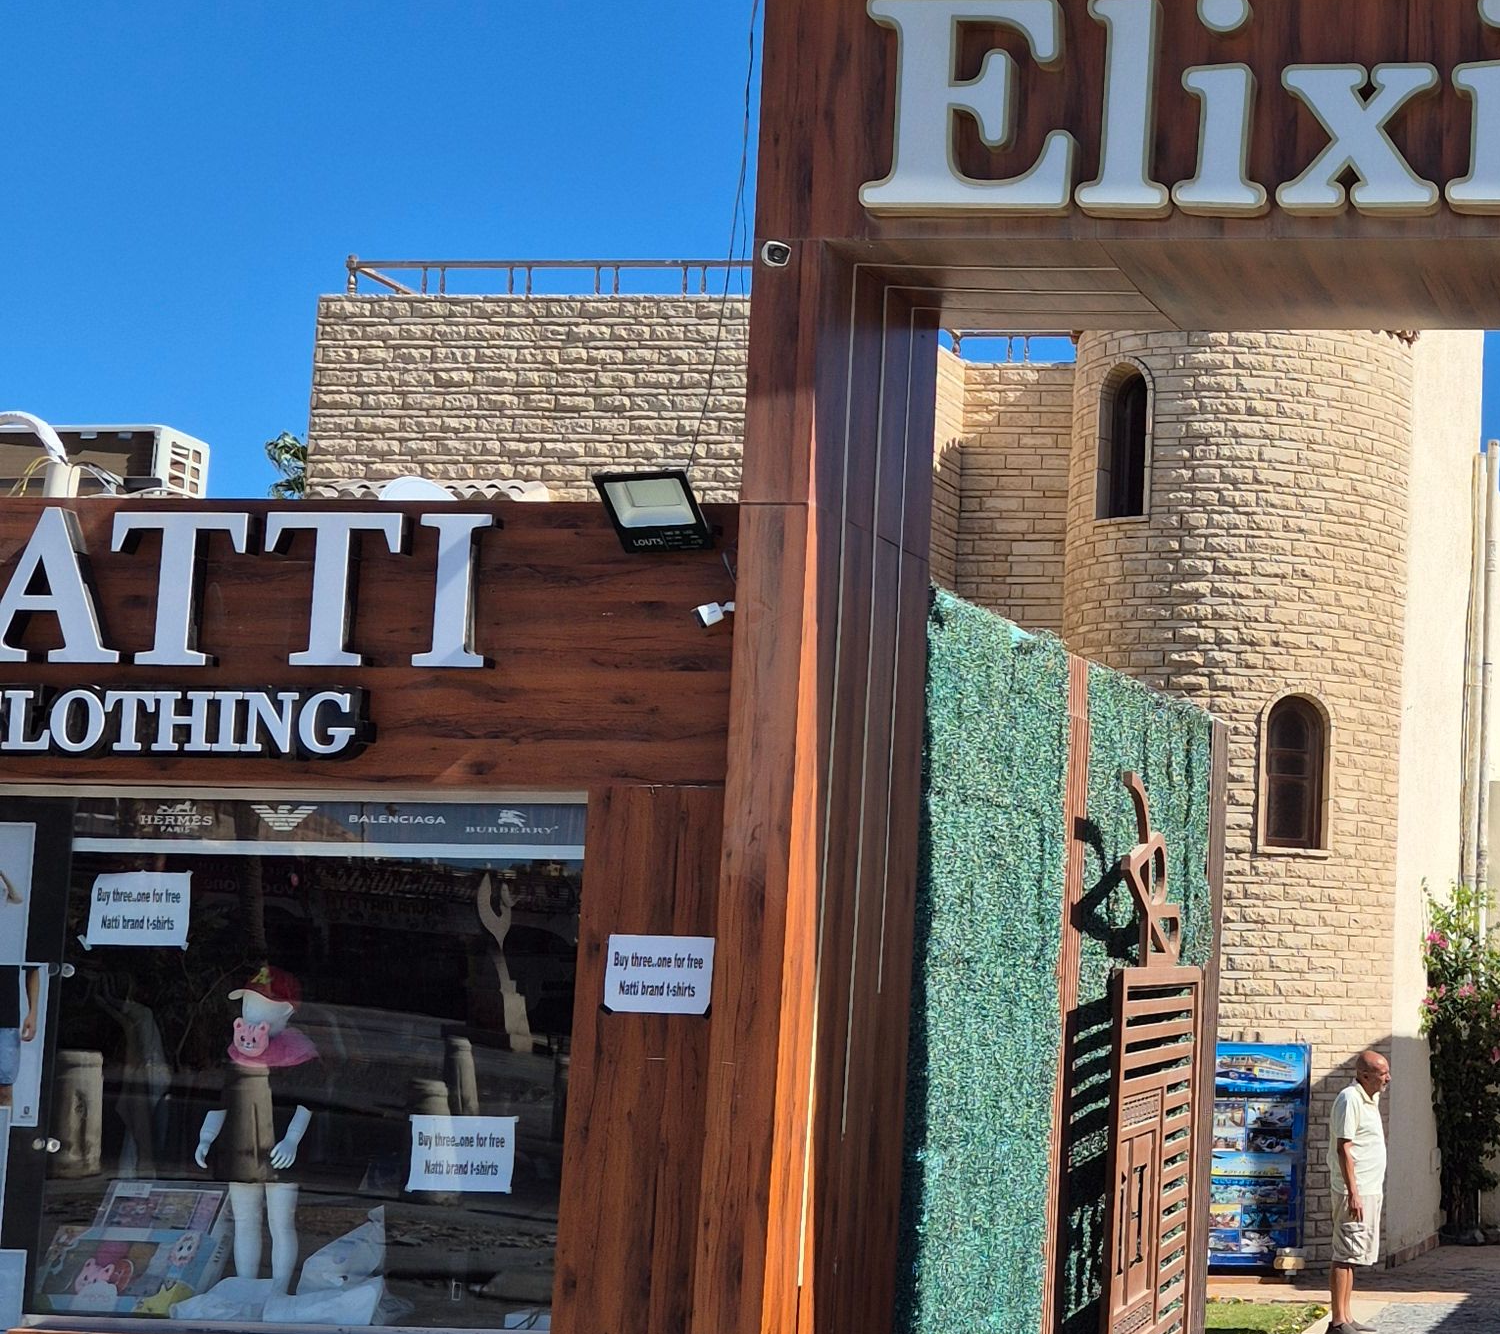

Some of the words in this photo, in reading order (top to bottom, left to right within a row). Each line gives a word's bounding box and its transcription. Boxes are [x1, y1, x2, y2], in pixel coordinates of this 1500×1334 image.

[0, 507, 494, 667] ATTI
[0, 688, 357, 756] LOTHING
[349, 814, 446, 825] BALENCIAGA
[97, 887, 111, 905] Buy
[152, 888, 164, 903] for
[165, 889, 181, 903] free
[101, 915, 121, 929] Natti
[122, 915, 145, 930] brand
[146, 916, 174, 930] t-shirts
[614, 951, 629, 970] Buy
[673, 953, 685, 969] for
[687, 953, 703, 969] free
[618, 980, 639, 996] Natti
[641, 981, 665, 996] brand
[666, 982, 696, 997] t-shirts
[418, 1132, 432, 1149] Buy
[475, 1132, 487, 1147] for
[489, 1133, 505, 1148] free
[424, 1159, 444, 1175] Natti
[445, 1160, 469, 1175] brand
[470, 1160, 499, 1176] t-shirts
